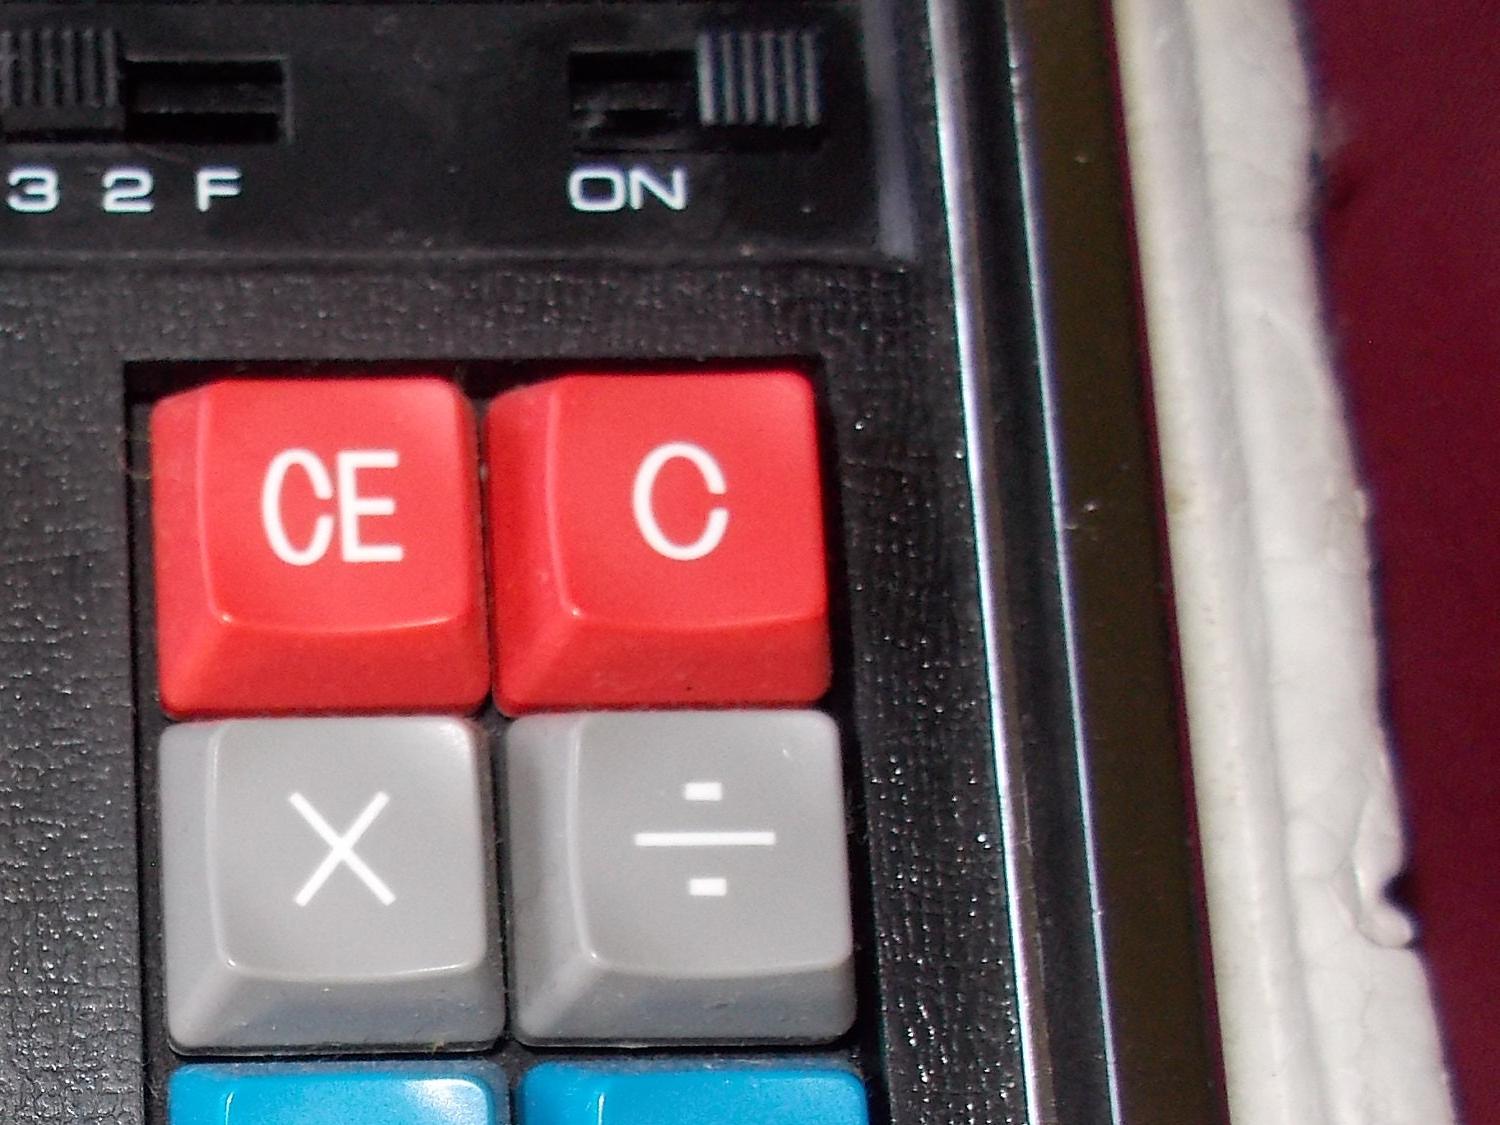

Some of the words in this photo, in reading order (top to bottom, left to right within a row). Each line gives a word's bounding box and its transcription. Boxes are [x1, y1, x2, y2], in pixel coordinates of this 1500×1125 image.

[7, 168, 59, 213] 3
[102, 168, 153, 213] 2
[195, 168, 244, 213] F
[568, 168, 687, 212] ON
[260, 448, 405, 567] CE
[631, 442, 730, 562] C
